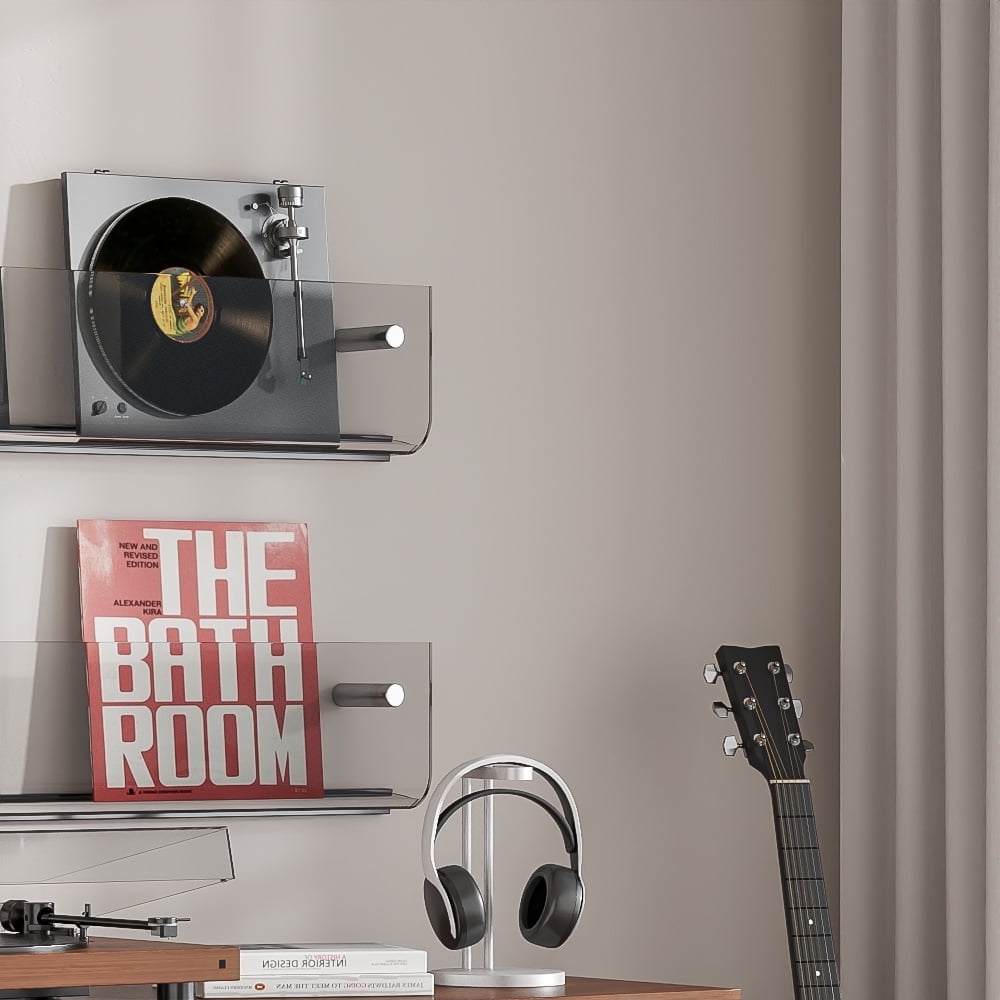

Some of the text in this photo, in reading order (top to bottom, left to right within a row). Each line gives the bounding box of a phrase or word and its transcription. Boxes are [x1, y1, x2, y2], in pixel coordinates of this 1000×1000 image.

[118, 542, 158, 551] NEW AND
[123, 551, 159, 560] REVISED
[126, 560, 159, 569] EDITION
[142, 528, 298, 617] THE
[113, 599, 162, 608] ALEXANDER
[142, 608, 162, 616] KIRA
[93, 616, 304, 702] BATH
[102, 704, 308, 788] ROOM
